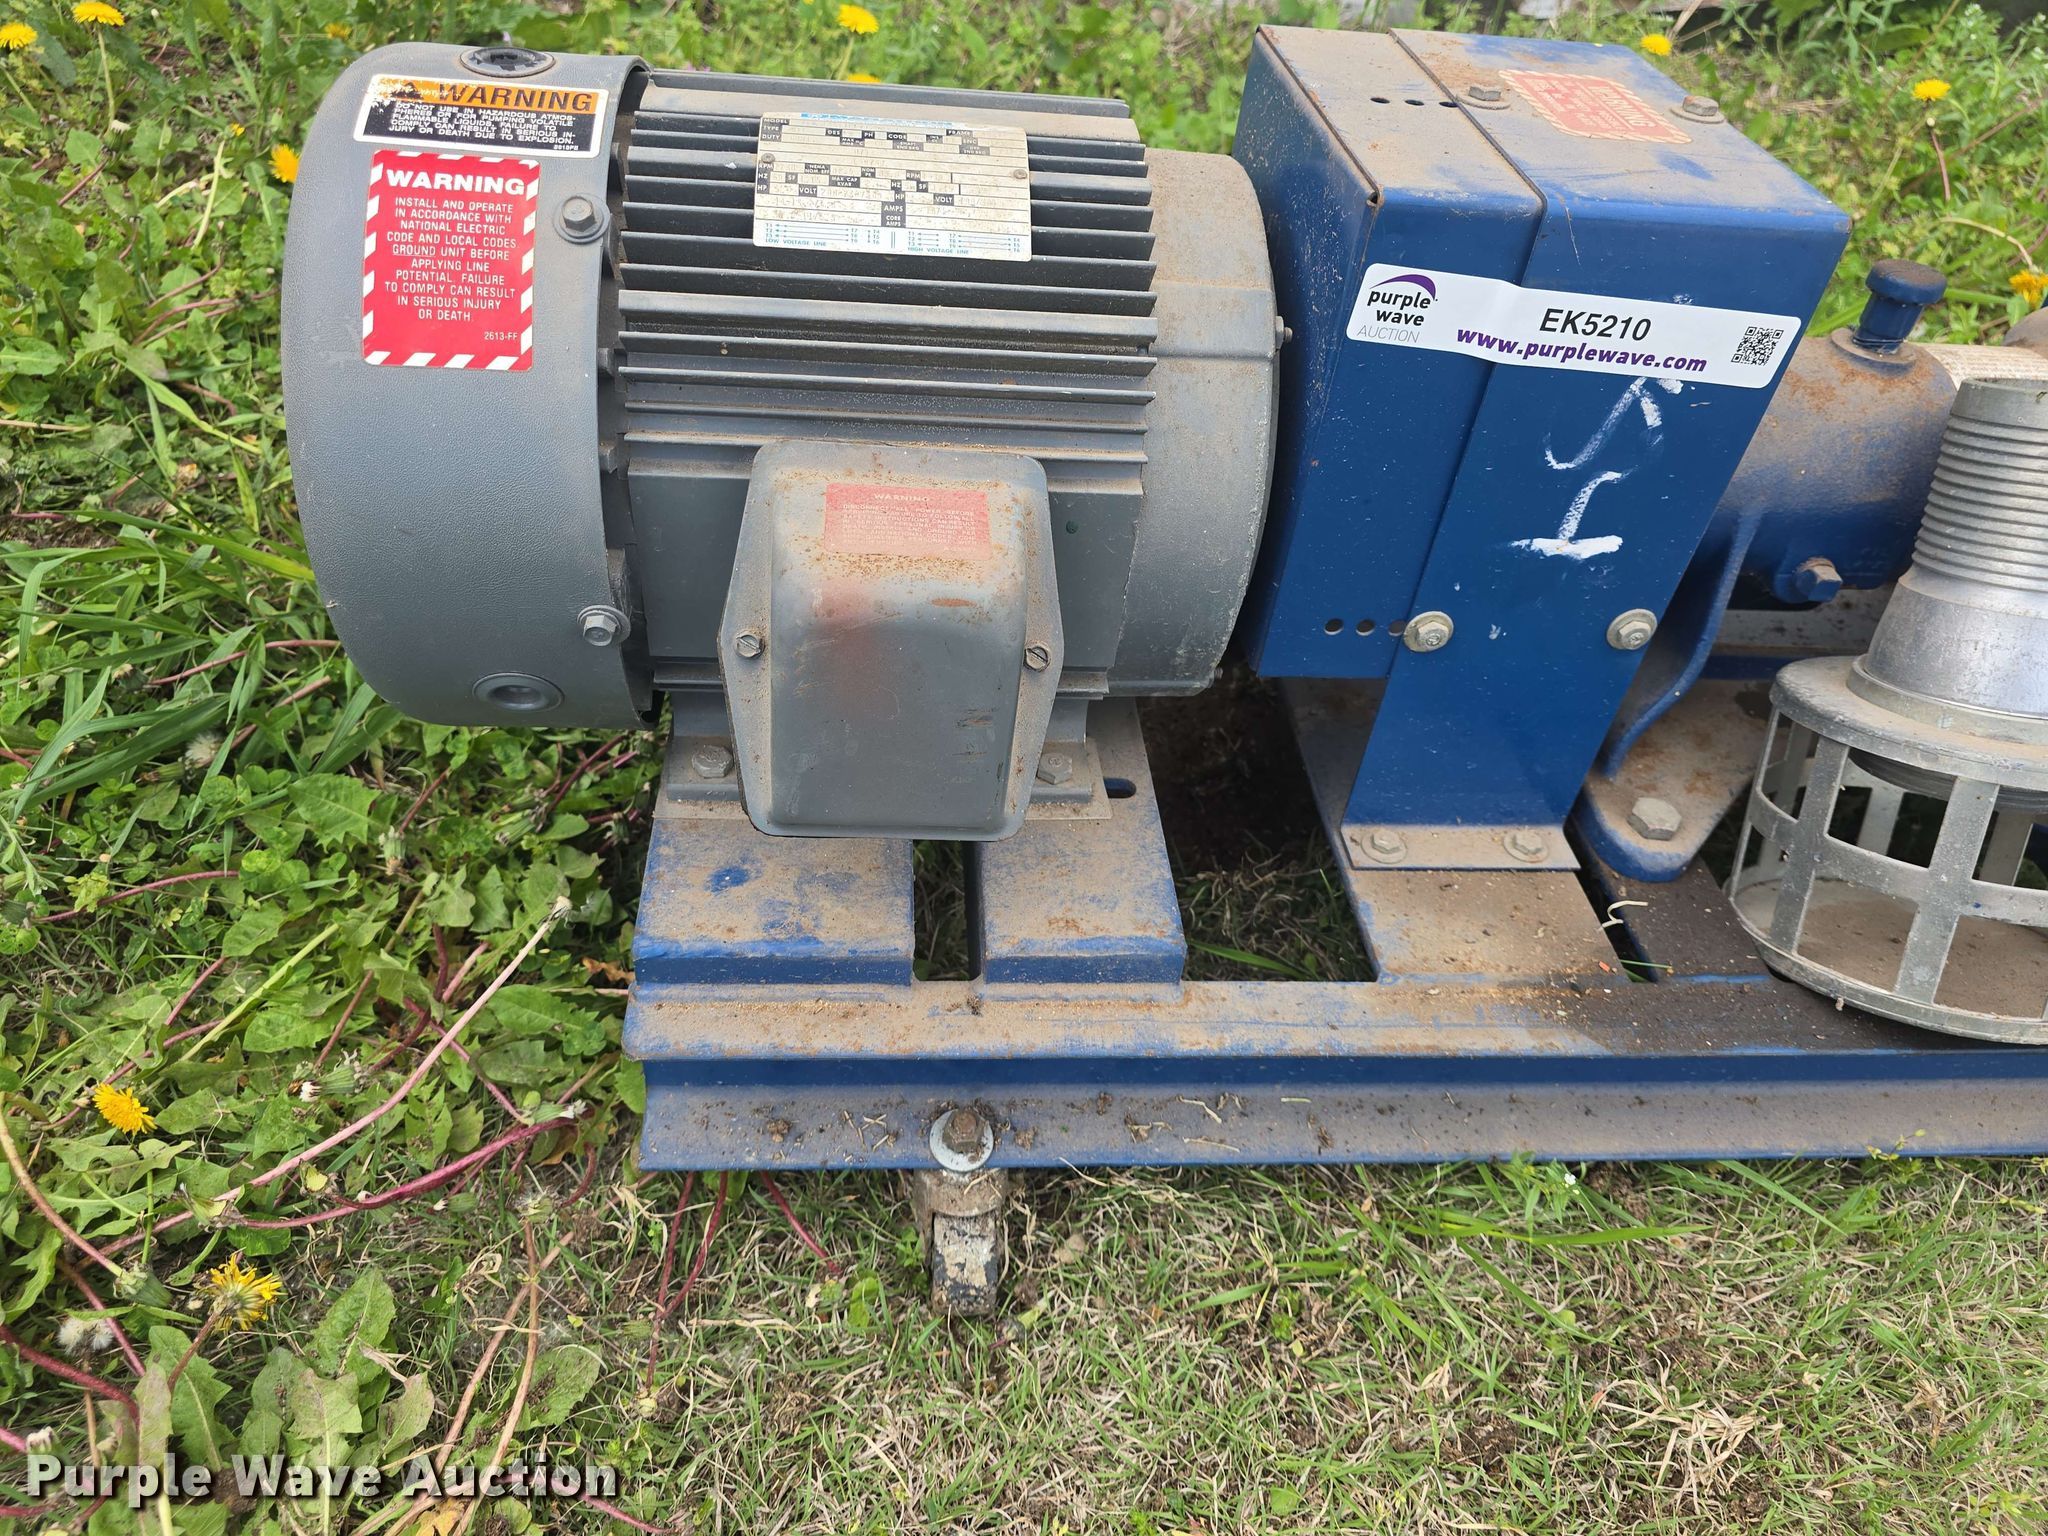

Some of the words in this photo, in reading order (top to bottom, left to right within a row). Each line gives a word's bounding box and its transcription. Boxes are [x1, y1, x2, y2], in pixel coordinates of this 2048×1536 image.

[439, 82, 593, 112] WARNING
[478, 109, 536, 118] HAZARDOUS
[482, 115, 524, 123] PUMPING
[530, 118, 574, 126] VOLATILE
[391, 120, 430, 128] COMPLY
[516, 129, 558, 137] SERIOUS
[392, 114, 449, 124] FLAMMABLE
[454, 118, 494, 127] LIQUIDS.
[500, 122, 538, 130] FAILURE
[438, 129, 470, 137] DEATH
[518, 136, 574, 144] EXPLOSION.
[386, 170, 525, 195] WARNING
[396, 198, 438, 209] INSTALL
[443, 200, 464, 210] AND
[469, 202, 514, 213] OPERATE
[396, 208, 406, 218] IN
[411, 209, 480, 222] ACCORDANCE
[485, 214, 512, 224] WITH
[400, 220, 452, 232] NATIONAL
[457, 224, 506, 235] ELECTRIC
[387, 232, 415, 242] CODE
[419, 234, 440, 244] AND
[446, 235, 478, 246] LOCAL
[392, 245, 436, 256] GROUND
[441, 247, 465, 257] UNIT
[470, 248, 510, 260] BEFORE
[412, 259, 462, 271] APPLYING
[466, 261, 490, 272] LINE
[462, 274, 504, 285] FAILURE
[385, 282, 398, 292] TO
[403, 283, 444, 294] COMPLY
[450, 285, 471, 296] CAN
[477, 287, 515, 298] RESULT
[398, 296, 407, 305] IN
[414, 297, 459, 308] SERIOUS
[463, 299, 501, 310] INJURY
[1367, 289, 1431, 312] purple
[419, 309, 432, 319] OR
[1376, 307, 1425, 328] wave
[1539, 308, 1651, 341] EK5210
[484, 332, 518, 341] 2613-FF
[1357, 324, 1420, 344] AUCTION
[1457, 328, 1708, 372] www.purplewave.com
[874, 493, 930, 502] WARNING
